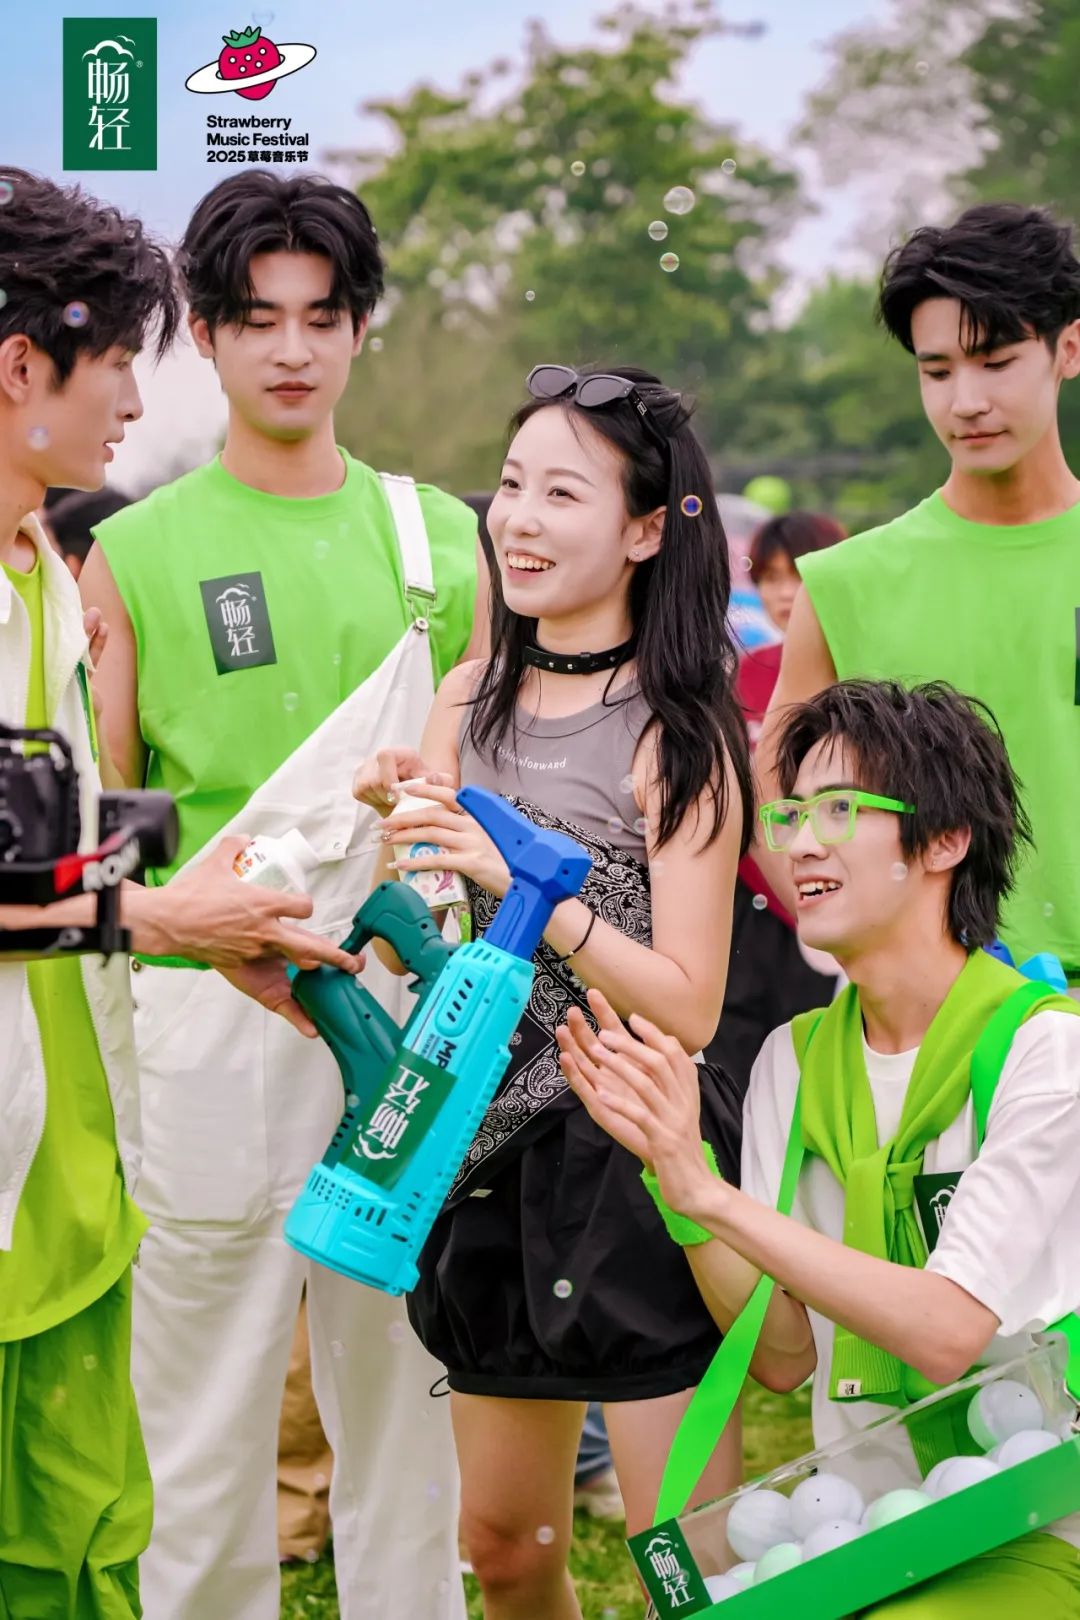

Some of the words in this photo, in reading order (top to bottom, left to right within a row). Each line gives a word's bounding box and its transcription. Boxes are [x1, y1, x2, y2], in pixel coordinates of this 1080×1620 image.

[220, 598, 260, 657] 畅轻
[365, 1064, 431, 1149] 畅轻
[649, 1547, 696, 1609] 畅轻
